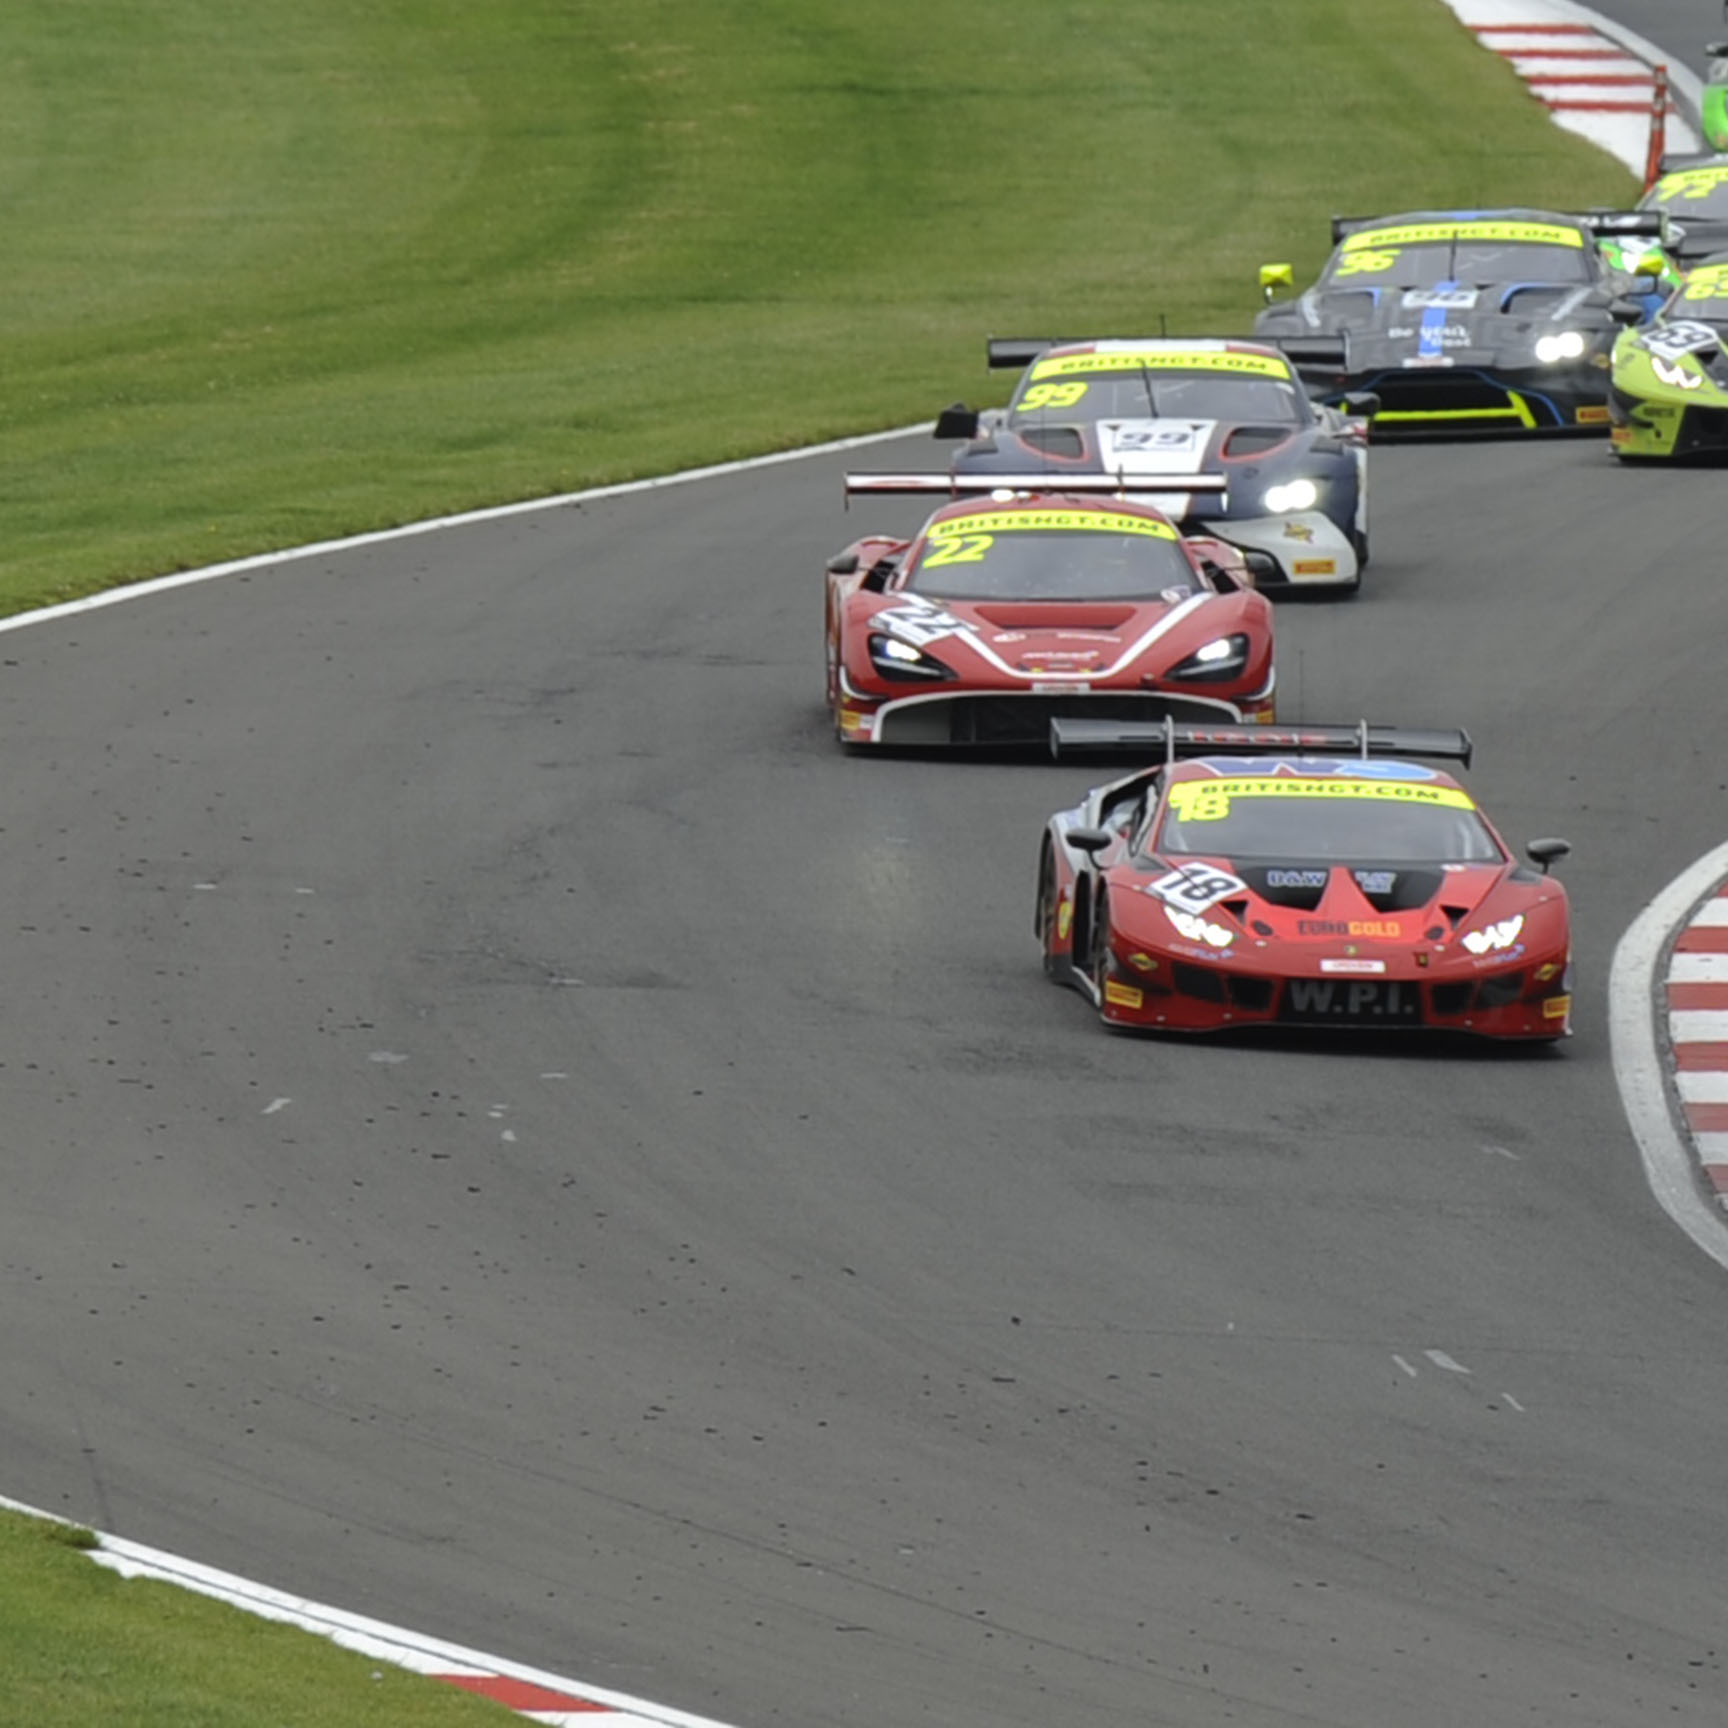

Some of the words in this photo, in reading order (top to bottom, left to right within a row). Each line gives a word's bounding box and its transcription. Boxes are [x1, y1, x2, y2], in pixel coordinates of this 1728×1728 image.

[1016, 381, 1089, 412] 99
[922, 534, 995, 569] 22
[1169, 791, 1230, 822] 18
[1202, 782, 1440, 801] BRITISHGT.COM
[1163, 867, 1238, 901] 18
[1289, 980, 1415, 1014] W.P.I.
